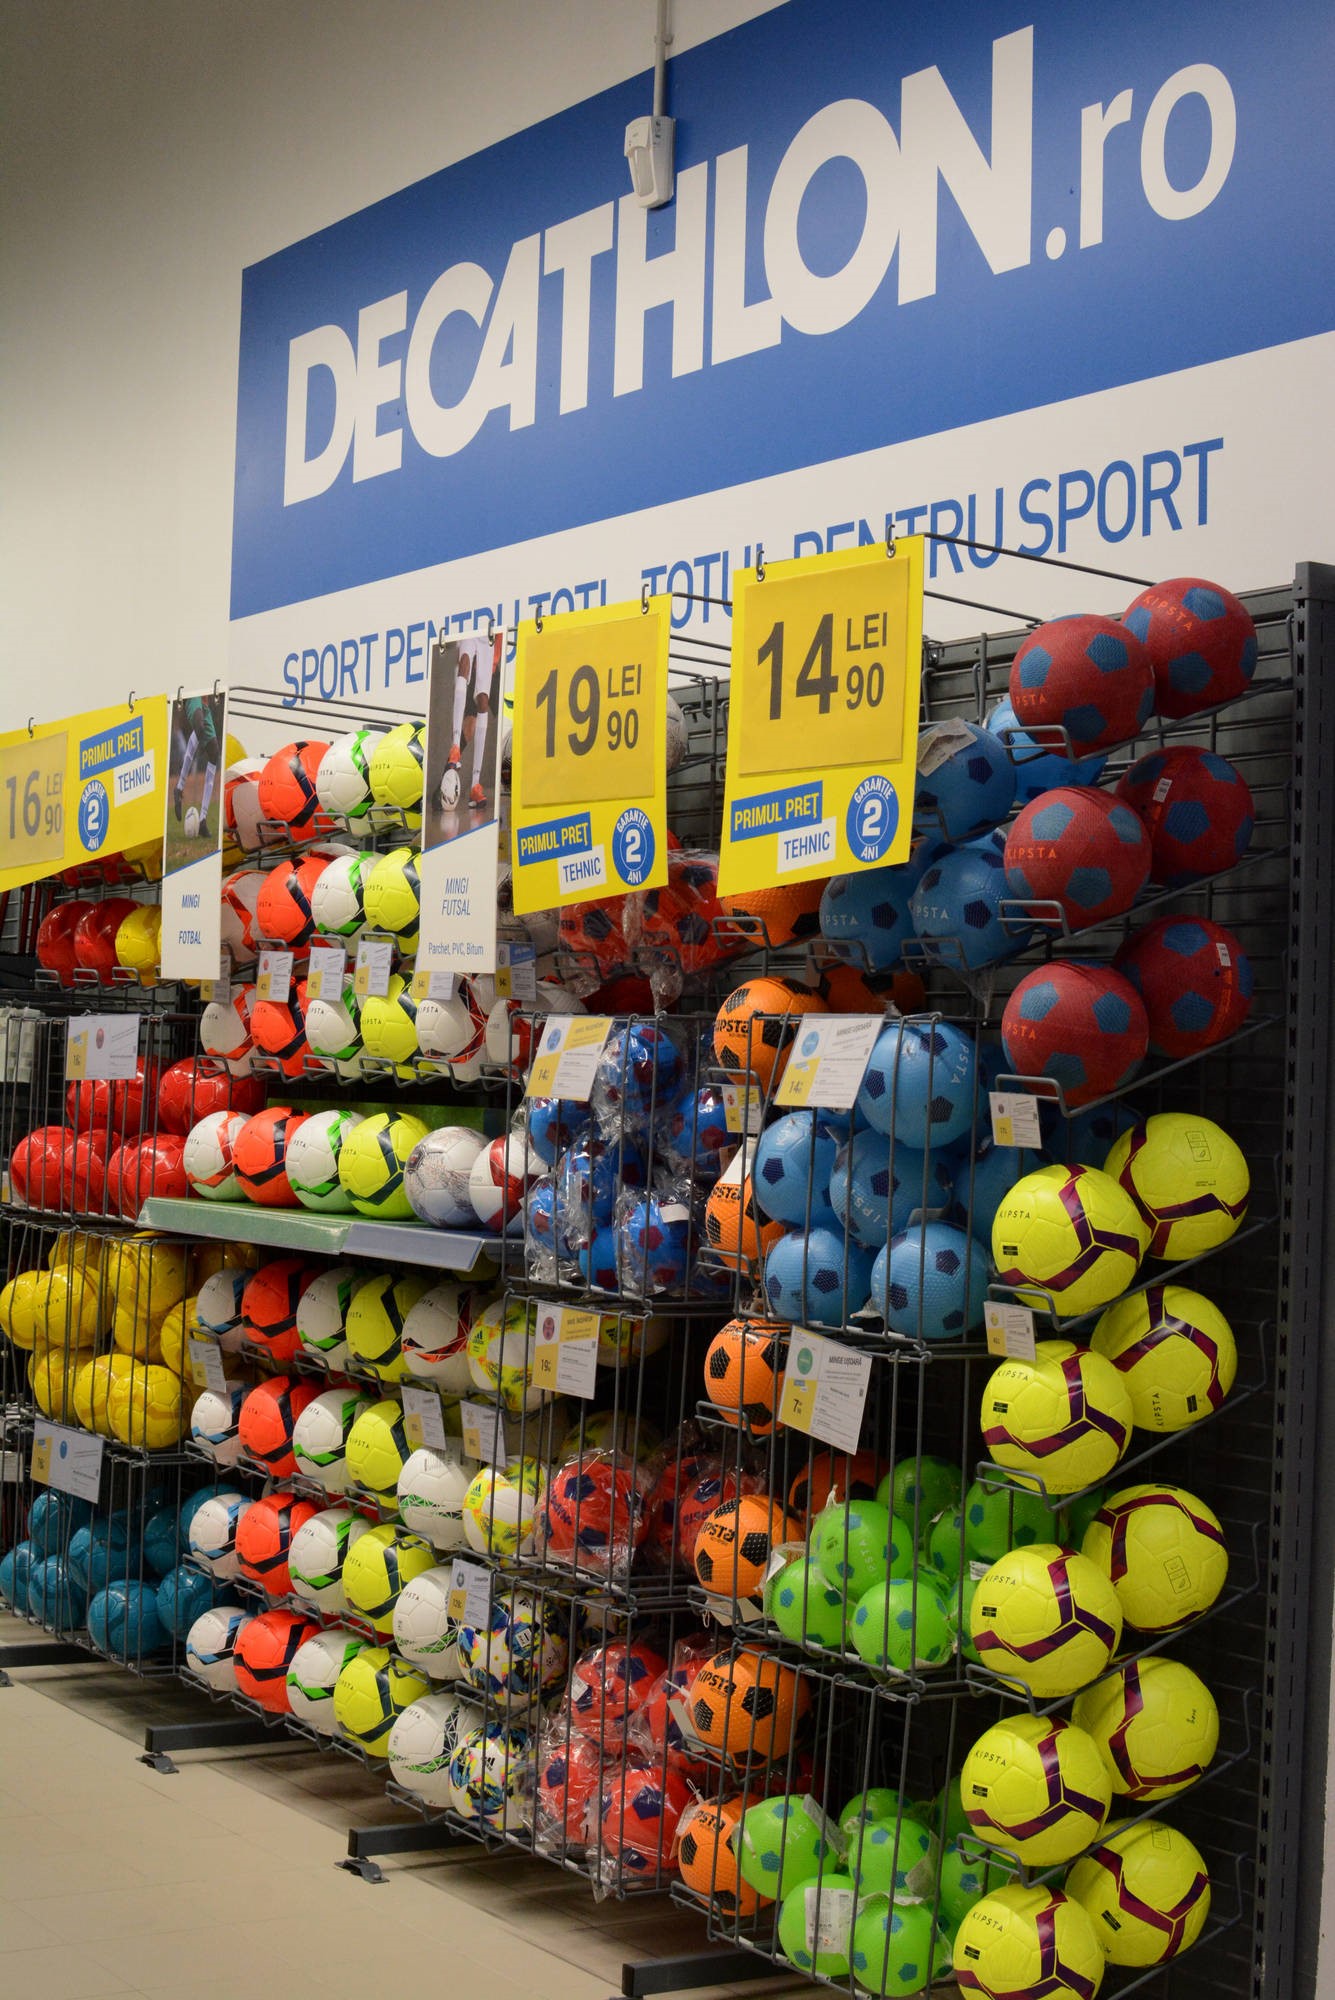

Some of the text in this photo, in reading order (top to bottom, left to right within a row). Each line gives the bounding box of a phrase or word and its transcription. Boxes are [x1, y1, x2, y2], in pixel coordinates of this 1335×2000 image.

[282, 633, 379, 709] SPORT
[1018, 437, 1224, 558] SPORT
[1145, 594, 1194, 632] KIPSTA
[757, 612, 888, 721] 14 LEI
[845, 661, 884, 710] 90
[536, 664, 642, 758] 19 LEI
[607, 708, 639, 751] 90
[81, 738, 116, 771] PRIMUL
[118, 763, 151, 794] TEHNIC
[6, 770, 63, 839] 16 LEI
[44, 803, 62, 836] 90
[87, 798, 100, 831] 2
[734, 803, 782, 832] PRIMUL
[862, 799, 882, 837] 2
[87, 836, 100, 850] ANI
[520, 829, 560, 857] PRIMUL
[626, 828, 641, 863] 2
[784, 831, 830, 860] TEHNIC
[860, 845, 879, 860] ANI
[563, 857, 601, 883] TEHNIC
[627, 870, 642, 884] ANI
[181, 894, 200, 909] MINGI
[445, 877, 469, 896] MINGI
[441, 899, 471, 917] FUTSAL
[178, 930, 202, 945] FOTBAL
[428, 942, 484, 956] Parchet, PVC, Bitum
[974, 1749, 1007, 1767] KIPSTA
